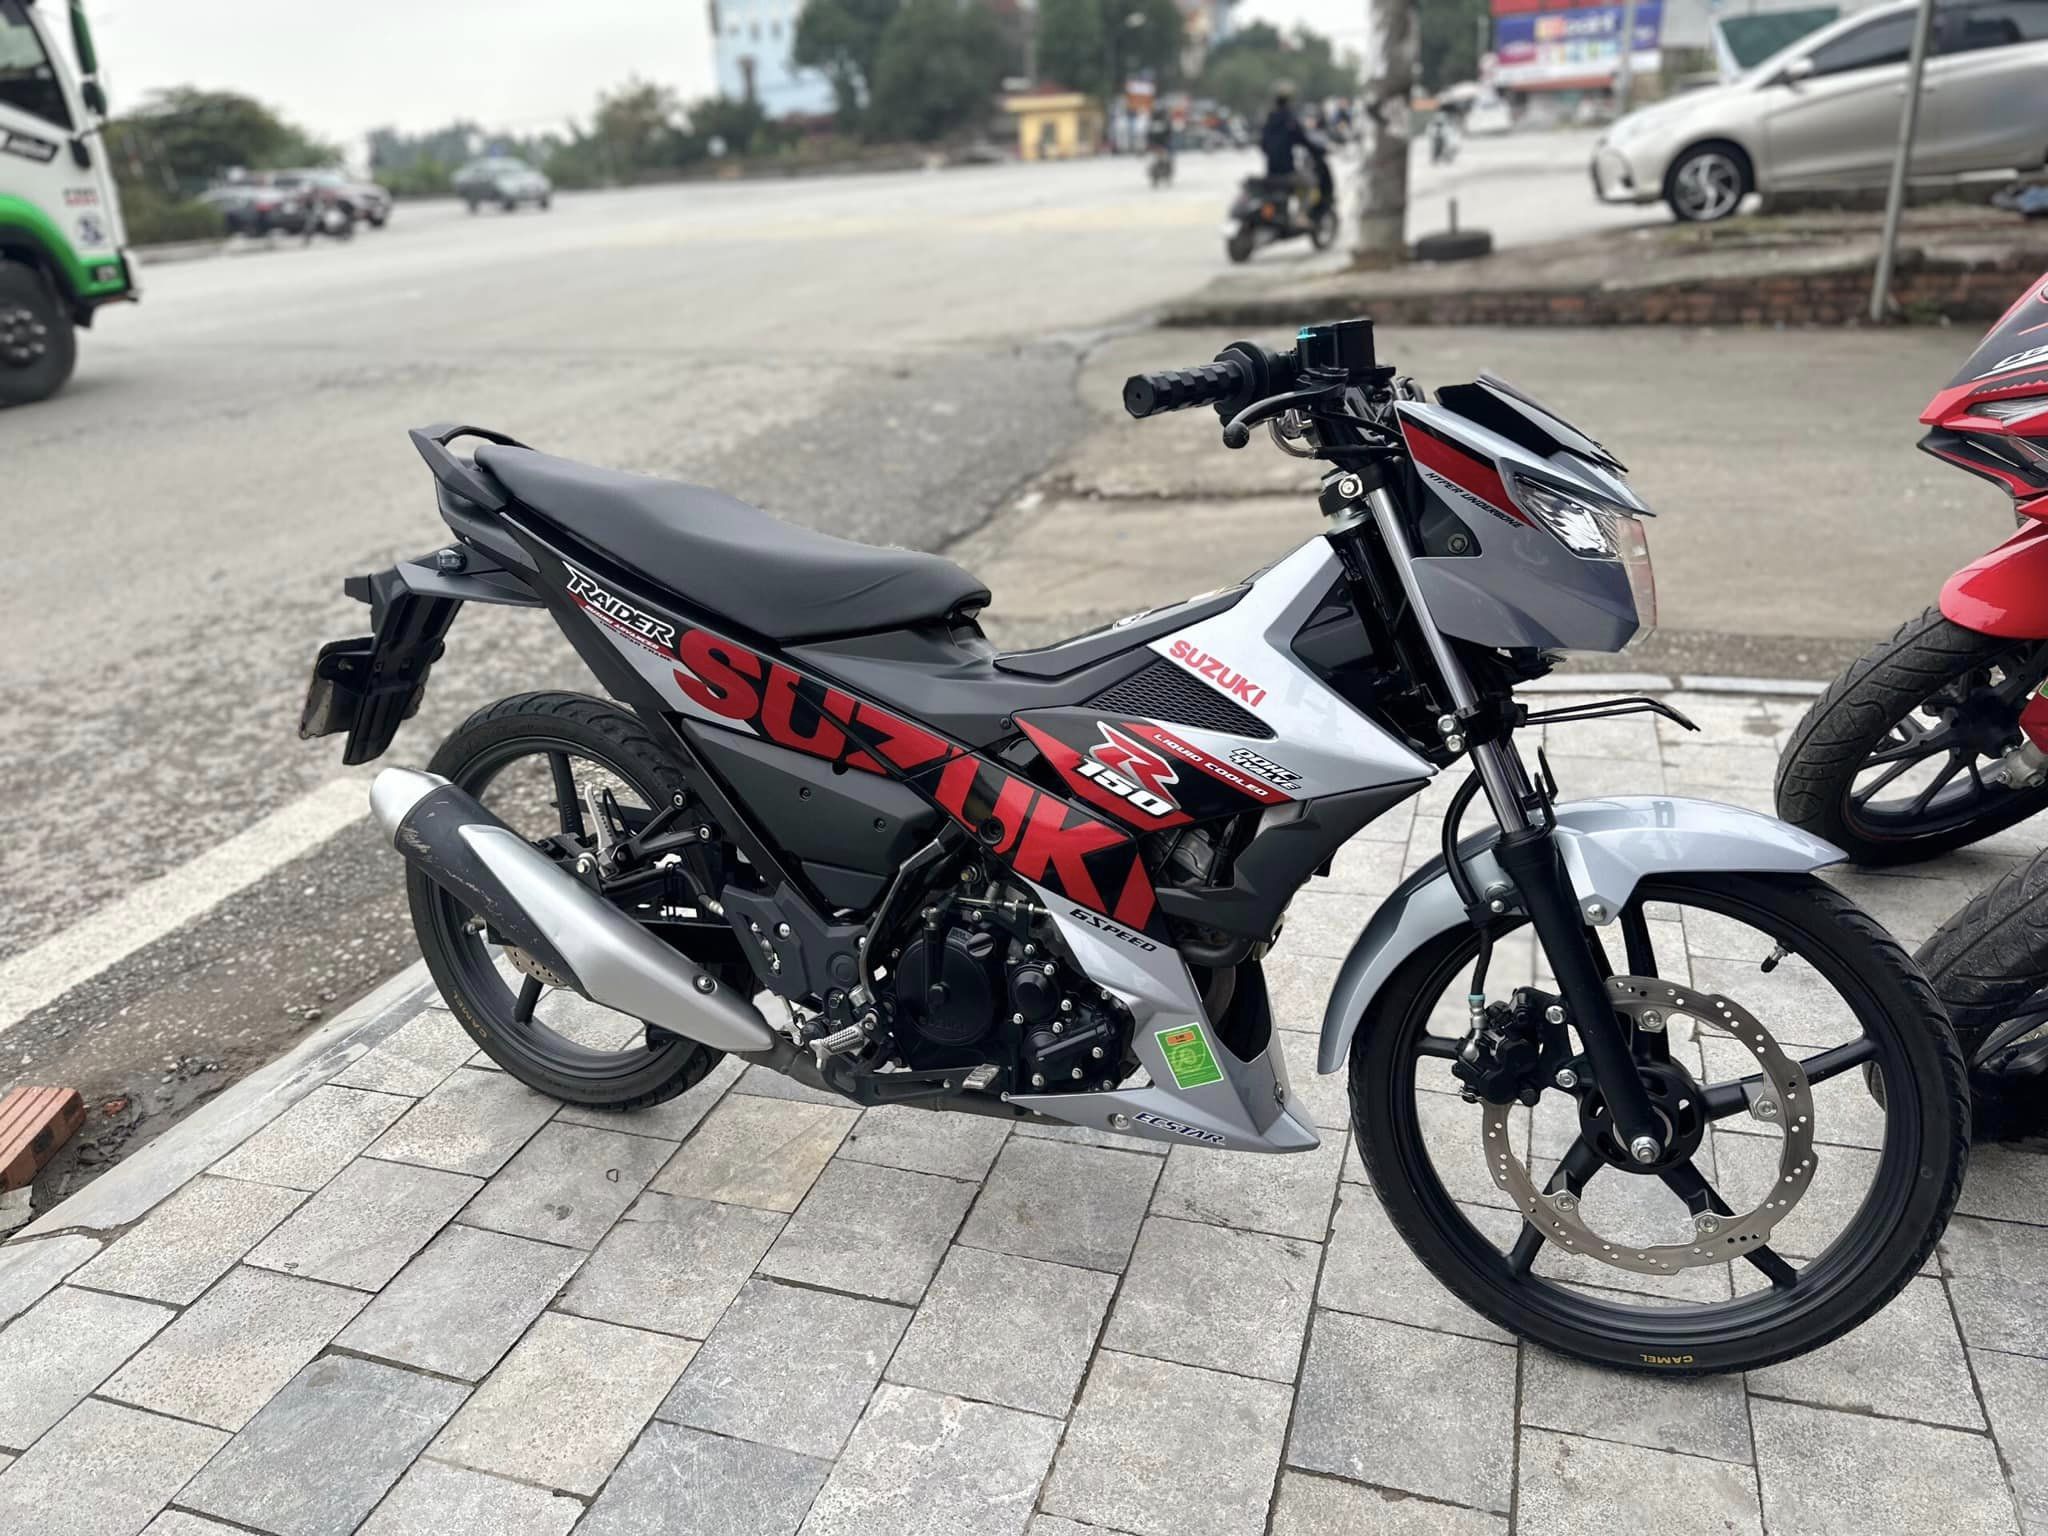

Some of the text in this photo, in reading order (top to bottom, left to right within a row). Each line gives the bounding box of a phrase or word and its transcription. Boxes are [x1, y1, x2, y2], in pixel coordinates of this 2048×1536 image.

[1425, 472, 1525, 529] HYPER UNDERBONE
[562, 560, 676, 649] RAIDER
[1169, 640, 1267, 708] SUZUKI
[673, 628, 1156, 931] SUZUKI
[1074, 757, 1175, 817] 150
[1153, 733, 1269, 797] LIQUID COOLED
[1232, 749, 1301, 780] DOHC
[1069, 908, 1158, 952] 6SPEED
[453, 990, 488, 1039] CAMEL
[1132, 1112, 1226, 1146] ECSTAR
[1639, 1353, 1694, 1365] CAMEL
